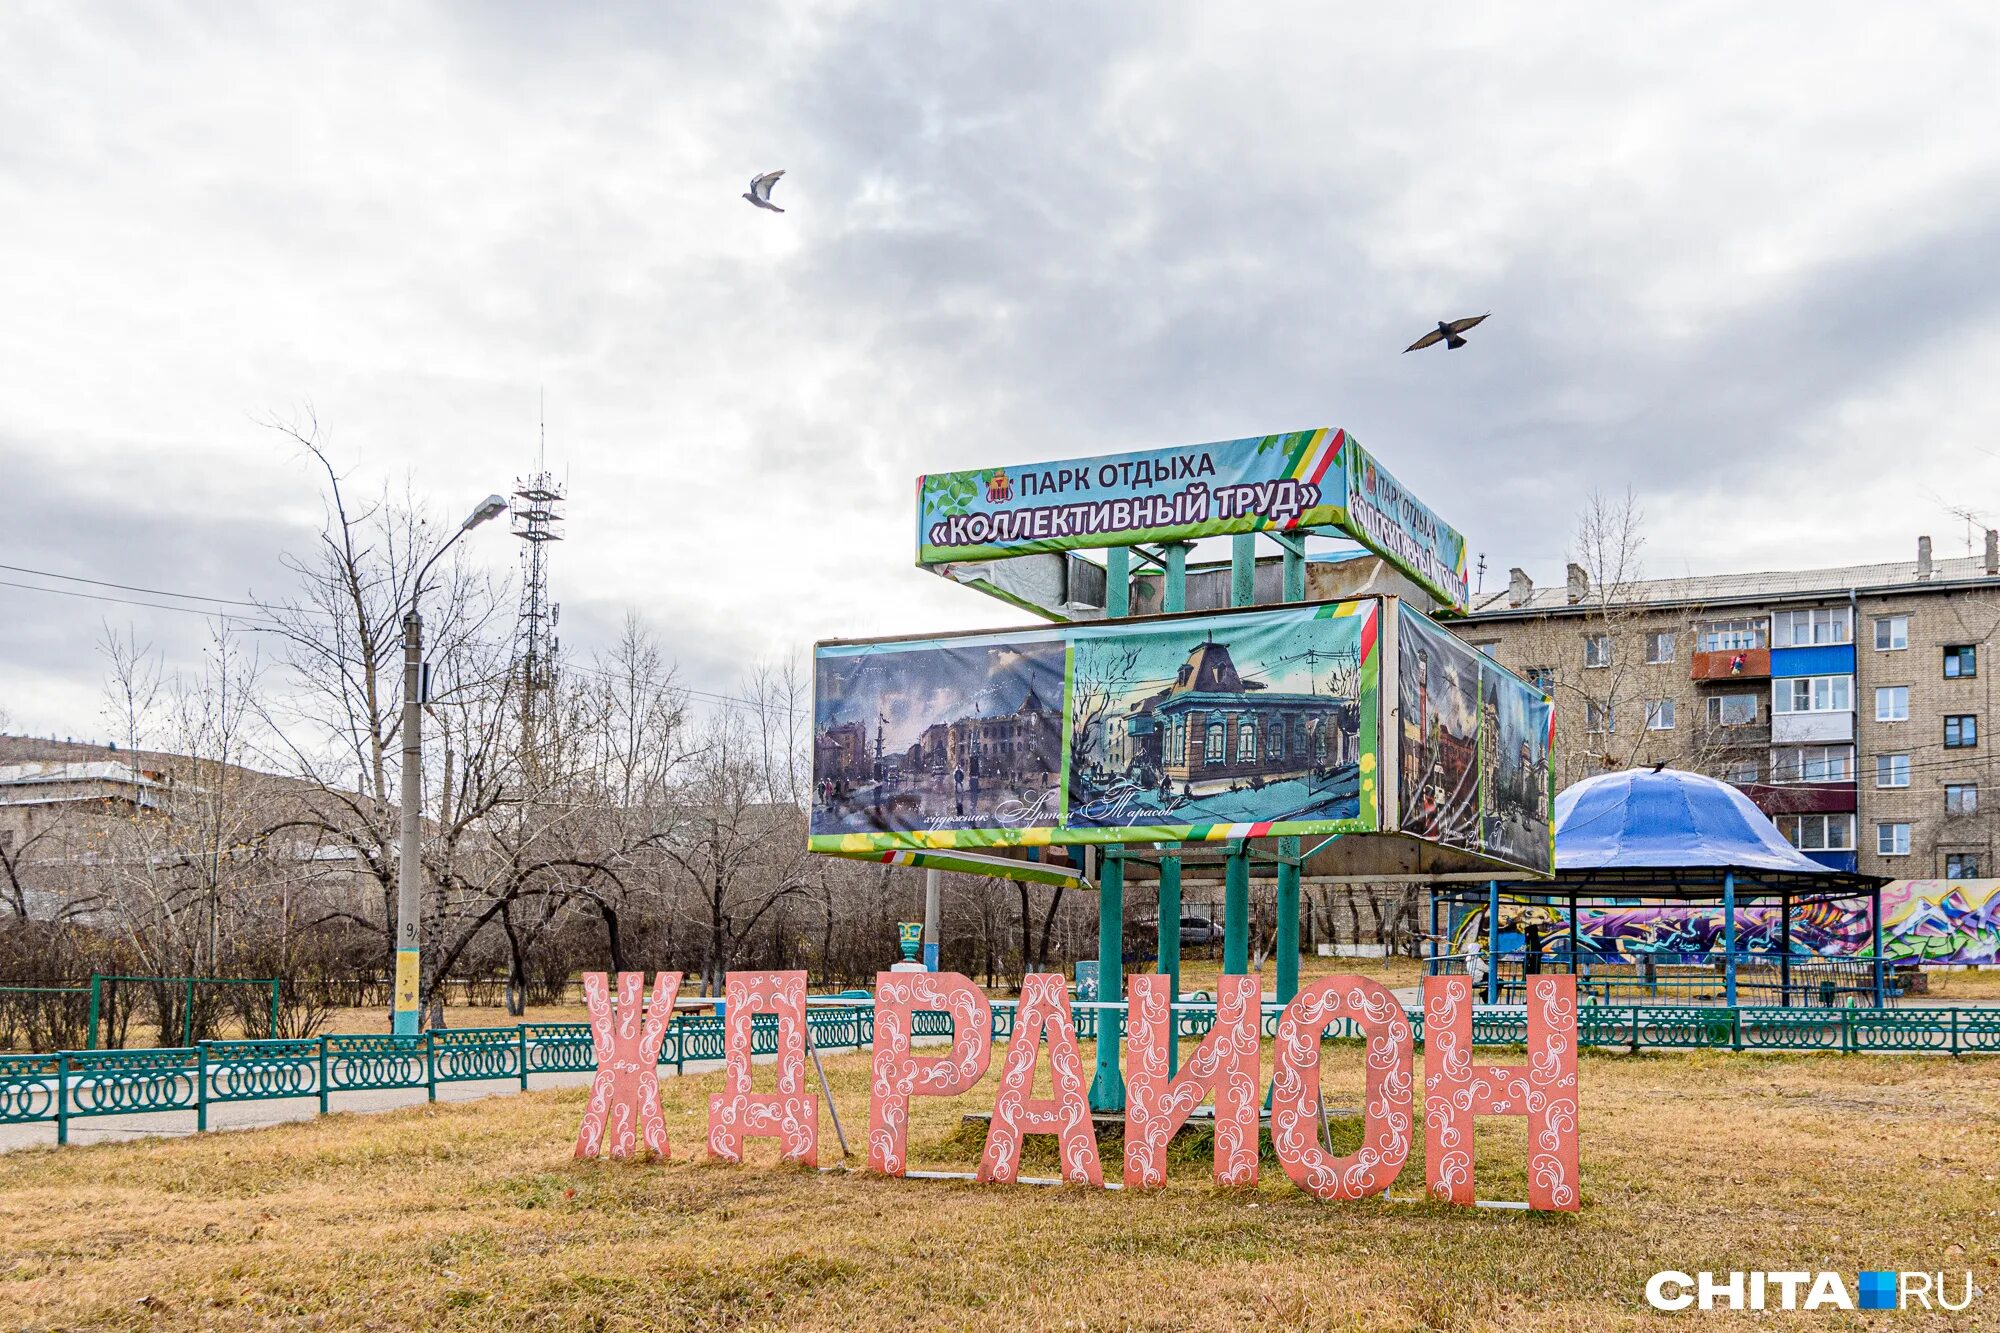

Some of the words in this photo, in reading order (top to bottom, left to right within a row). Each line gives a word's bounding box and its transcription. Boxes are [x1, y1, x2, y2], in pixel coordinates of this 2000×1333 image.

[1020, 466, 1090, 497] ПАРК
[1098, 452, 1216, 492] ОТДЫХА
[931, 487, 1209, 545] «КОЛЛЕКТИВНЫЙ
[1217, 481, 1320, 521] ТРУД»
[1080, 776, 1181, 827] Тарасов
[573, 970, 819, 1166] ЖД
